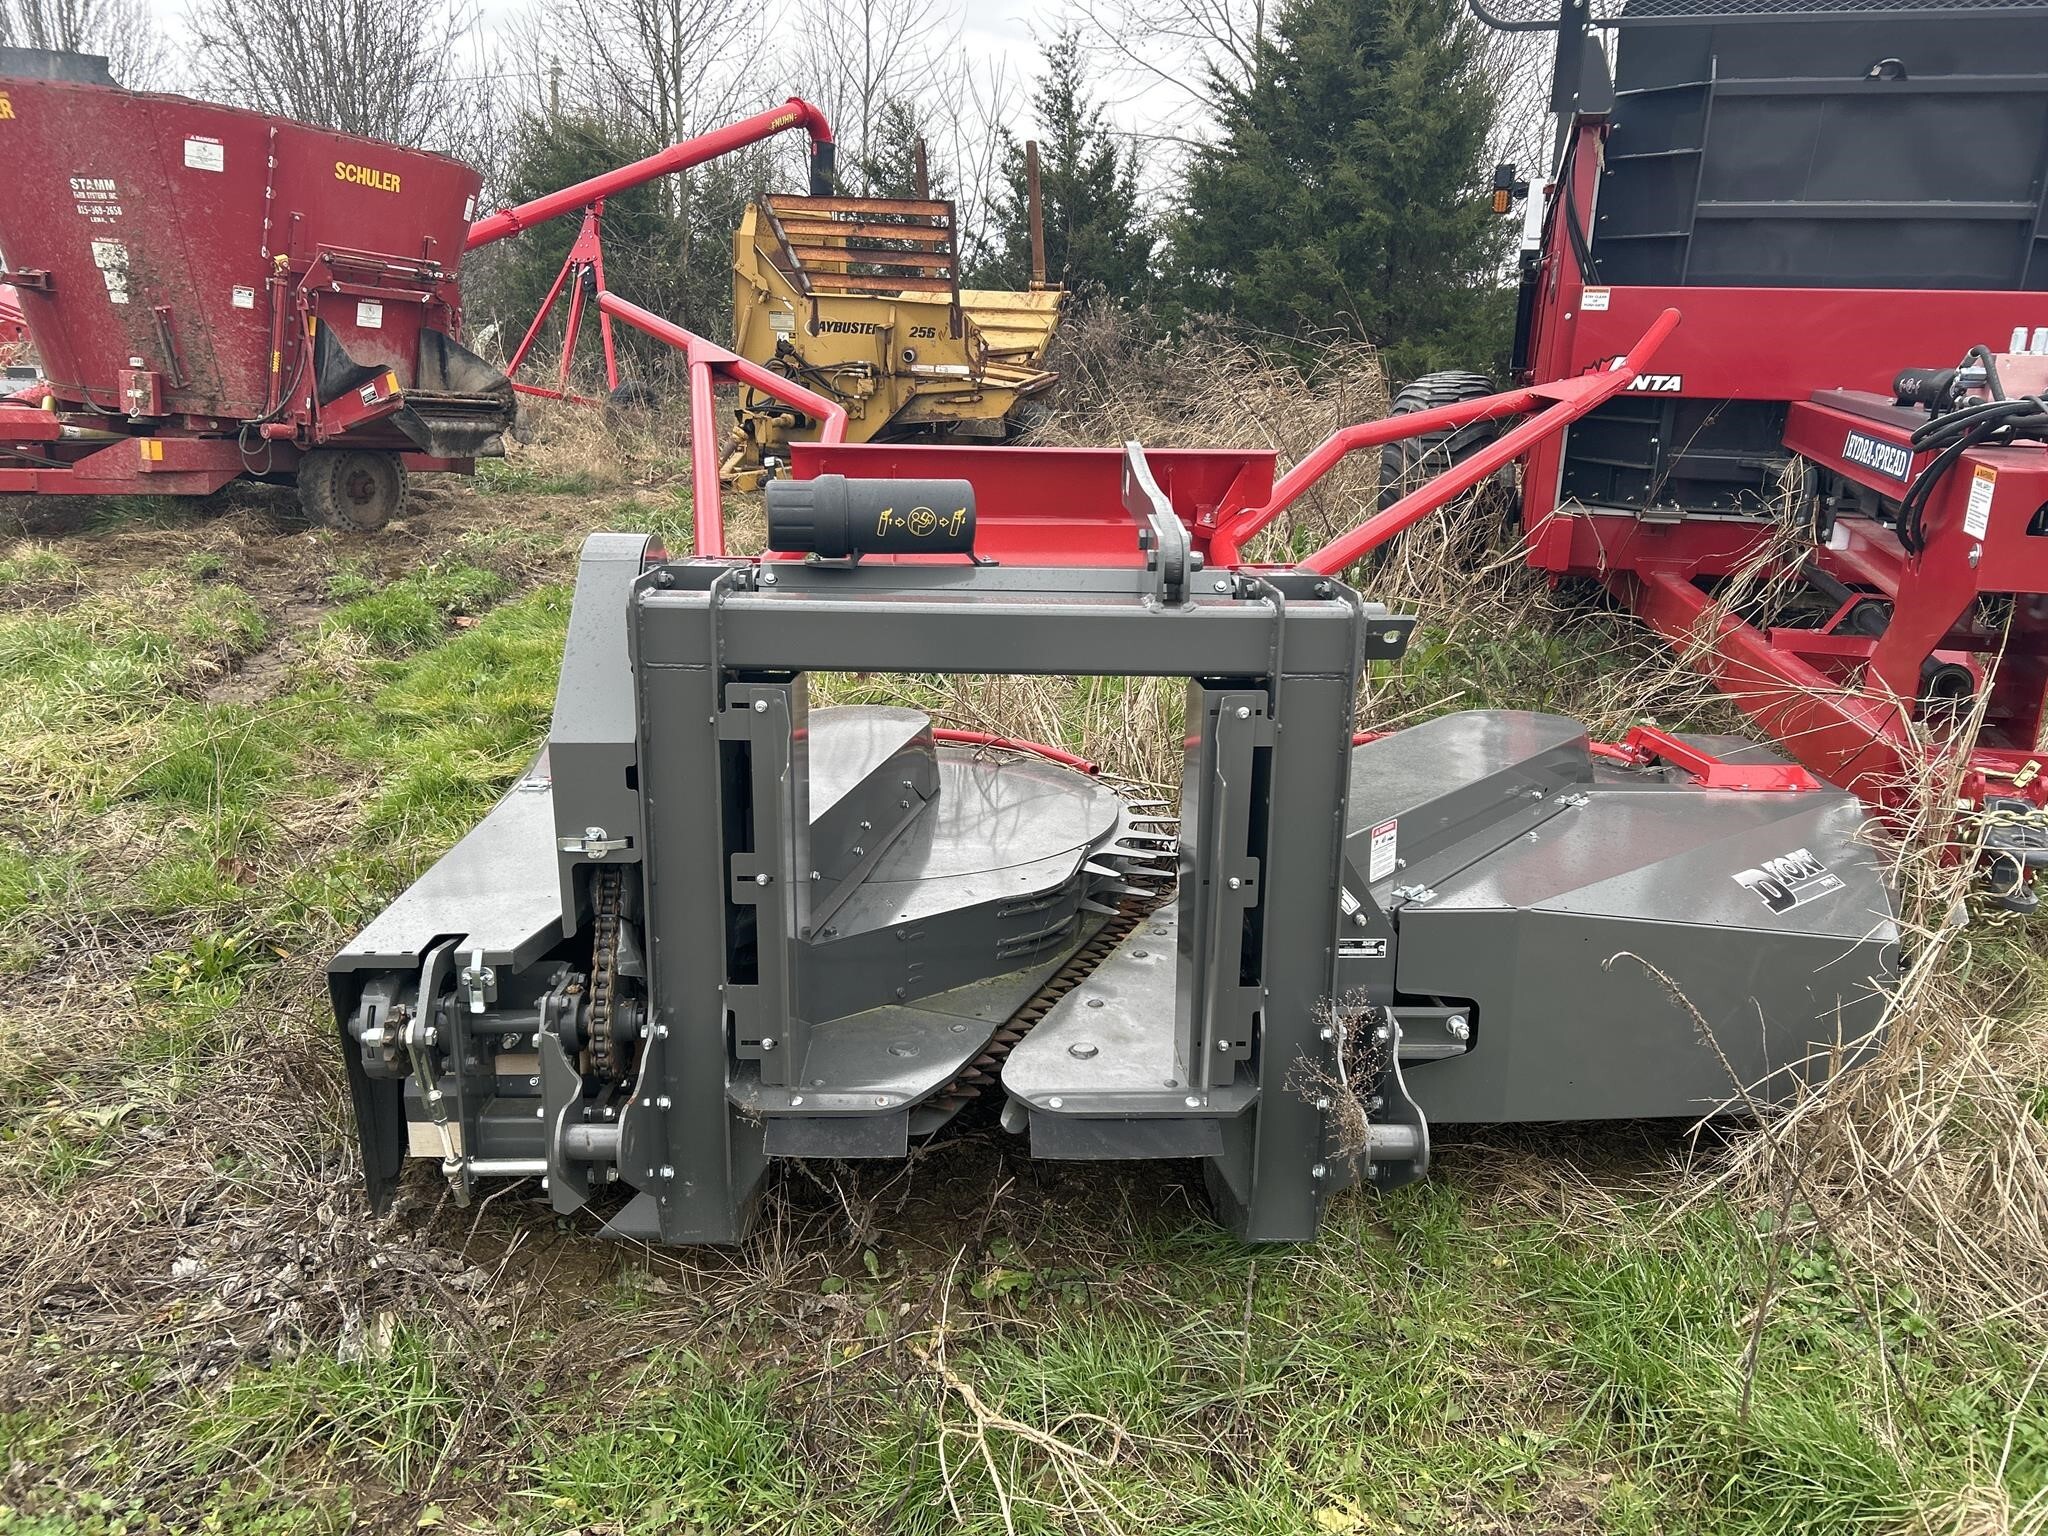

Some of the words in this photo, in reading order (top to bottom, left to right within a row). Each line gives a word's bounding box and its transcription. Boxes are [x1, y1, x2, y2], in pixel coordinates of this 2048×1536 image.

[69, 177, 116, 191] STAMM
[334, 161, 401, 193] SCHULER
[819, 320, 880, 335] AYBUSTE
[908, 326, 936, 339] 256
[1845, 434, 1908, 477] HYDRA-SPREAD
[1731, 848, 1828, 915] DION
